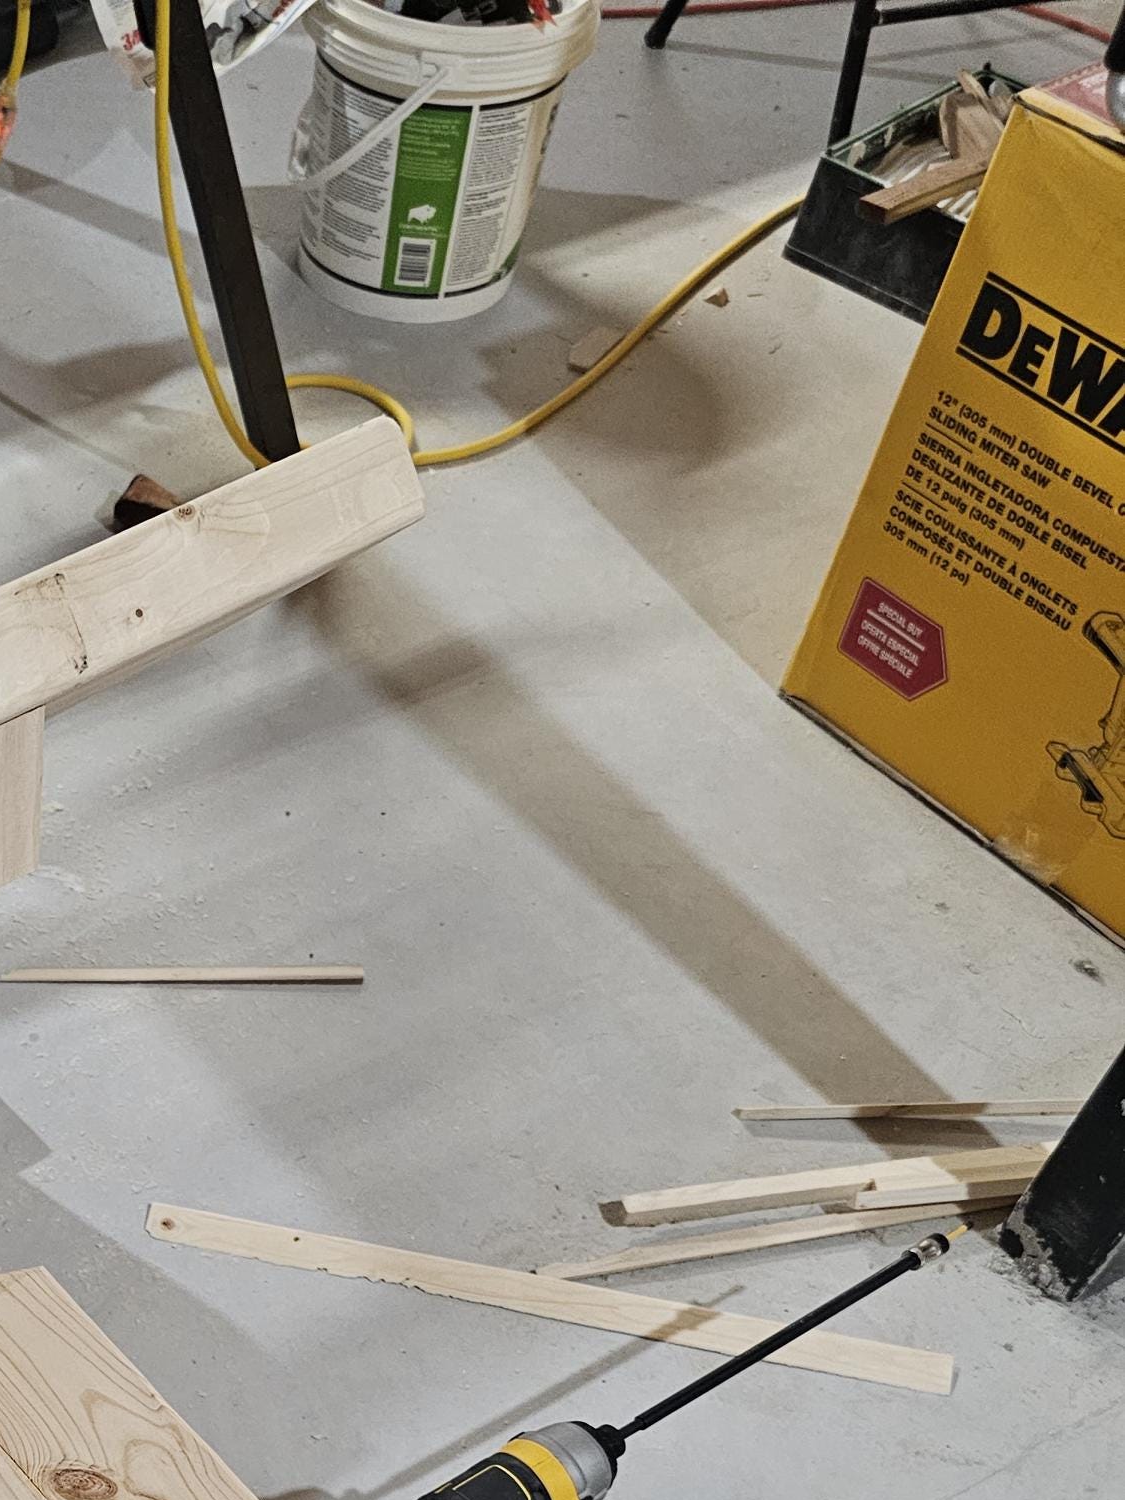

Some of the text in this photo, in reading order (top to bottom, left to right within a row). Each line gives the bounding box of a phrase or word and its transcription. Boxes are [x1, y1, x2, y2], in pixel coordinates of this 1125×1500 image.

[918, 432, 961, 467] SIERRA
[964, 460, 1049, 523] INGLETADORA
[928, 405, 1051, 489] SLIDING MITER SAW
[937, 390, 1114, 509] 12" (305 mm) DOUBLE BEVEL
[905, 464, 1024, 550] DE 12 pulg (305 mm)
[912, 448, 1088, 569] DESLIZANTE DE DOBLE BISEL
[883, 520, 970, 586] 305 mm (12 po)
[889, 505, 1072, 632] COMPOSÉS ET DOUBLE BISEAU
[895, 489, 1079, 616] SCIE COULISSANTE À ONGLETS
[857, 634, 880, 656] OFFRE
[861, 619, 919, 667] OFERTA ESPECIAL
[877, 601, 923, 638] SPECIAL BUY
